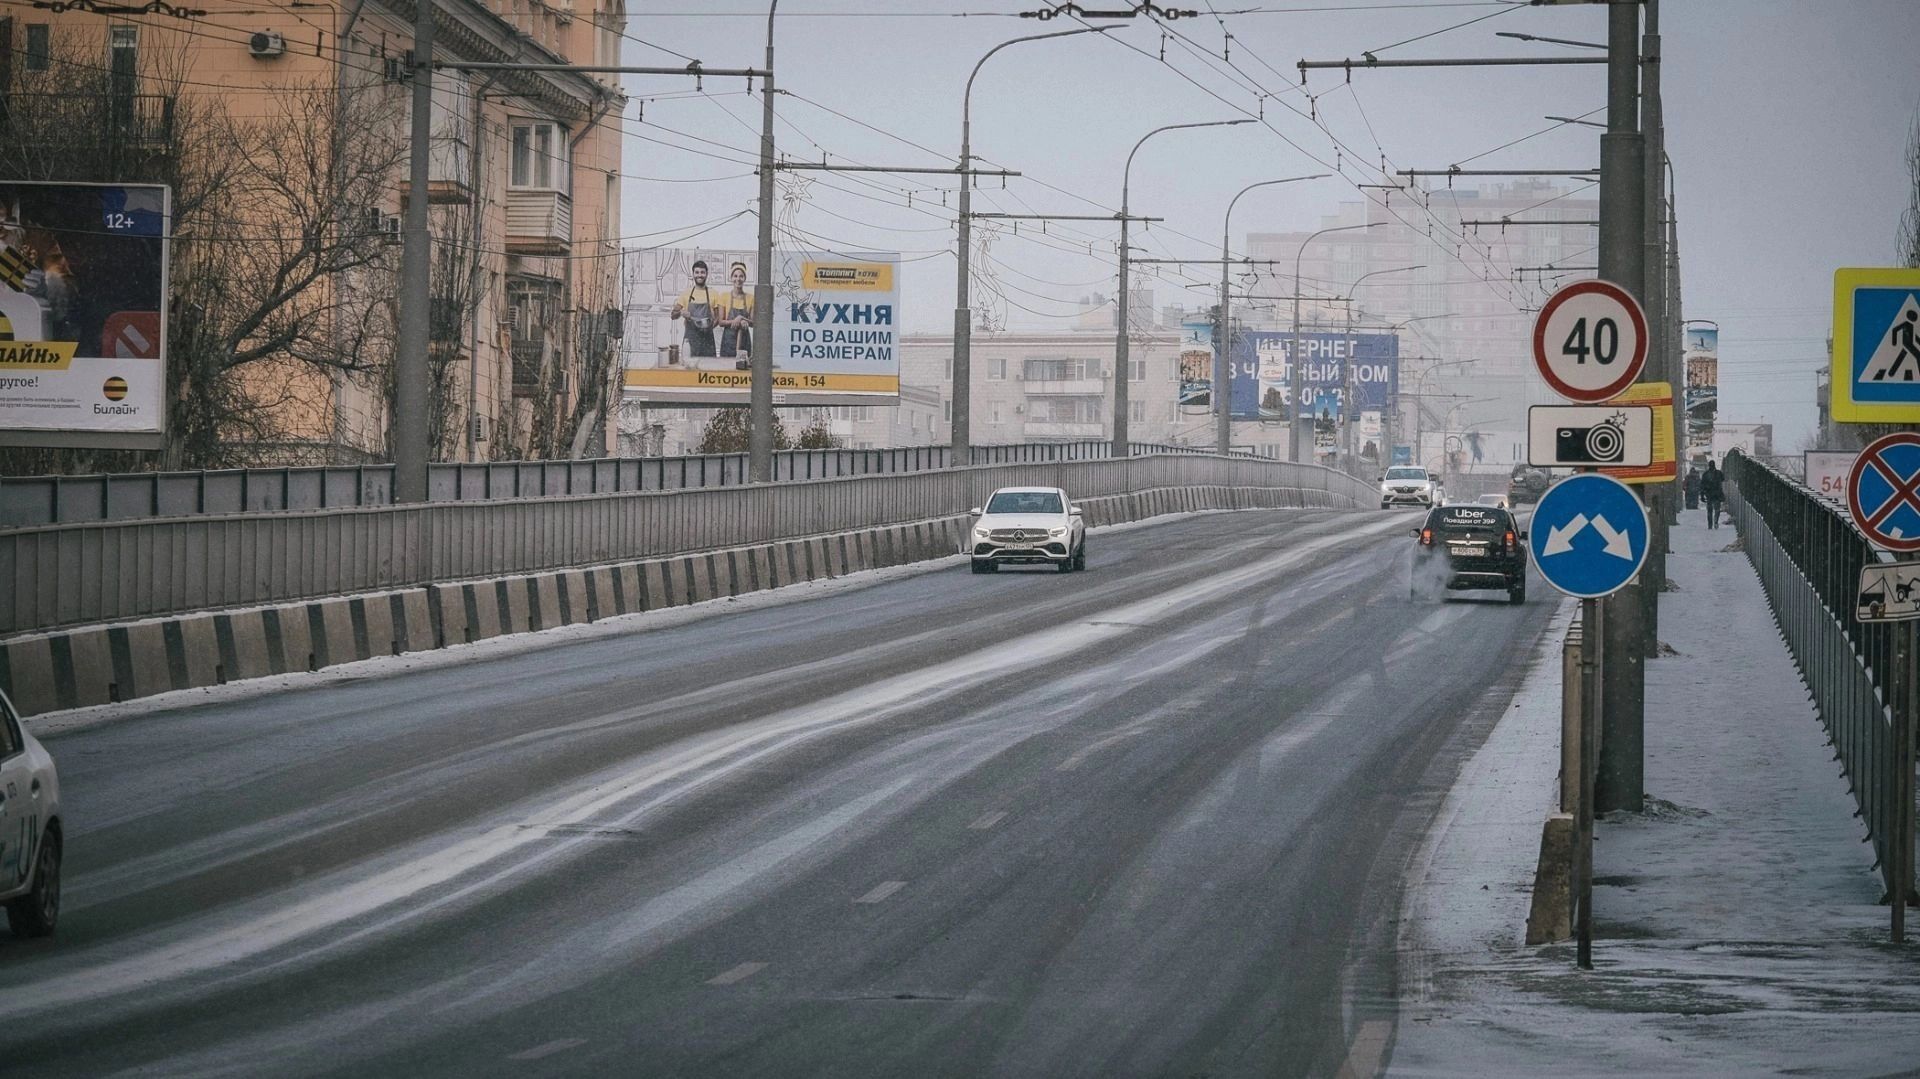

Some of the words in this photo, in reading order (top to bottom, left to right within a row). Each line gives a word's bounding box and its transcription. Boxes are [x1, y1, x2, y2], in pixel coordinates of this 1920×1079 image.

[106, 213, 135, 229] 12+
[791, 302, 892, 325] КУХНЯ
[790, 329, 816, 343] ПО
[822, 329, 892, 344] ВАШИМ
[1562, 317, 1619, 365] 40
[790, 345, 892, 360] РАЗМЕРАМ
[803, 375, 826, 387] 154
[93, 404, 137, 415] Билайн
[1455, 509, 1485, 518] Uber
